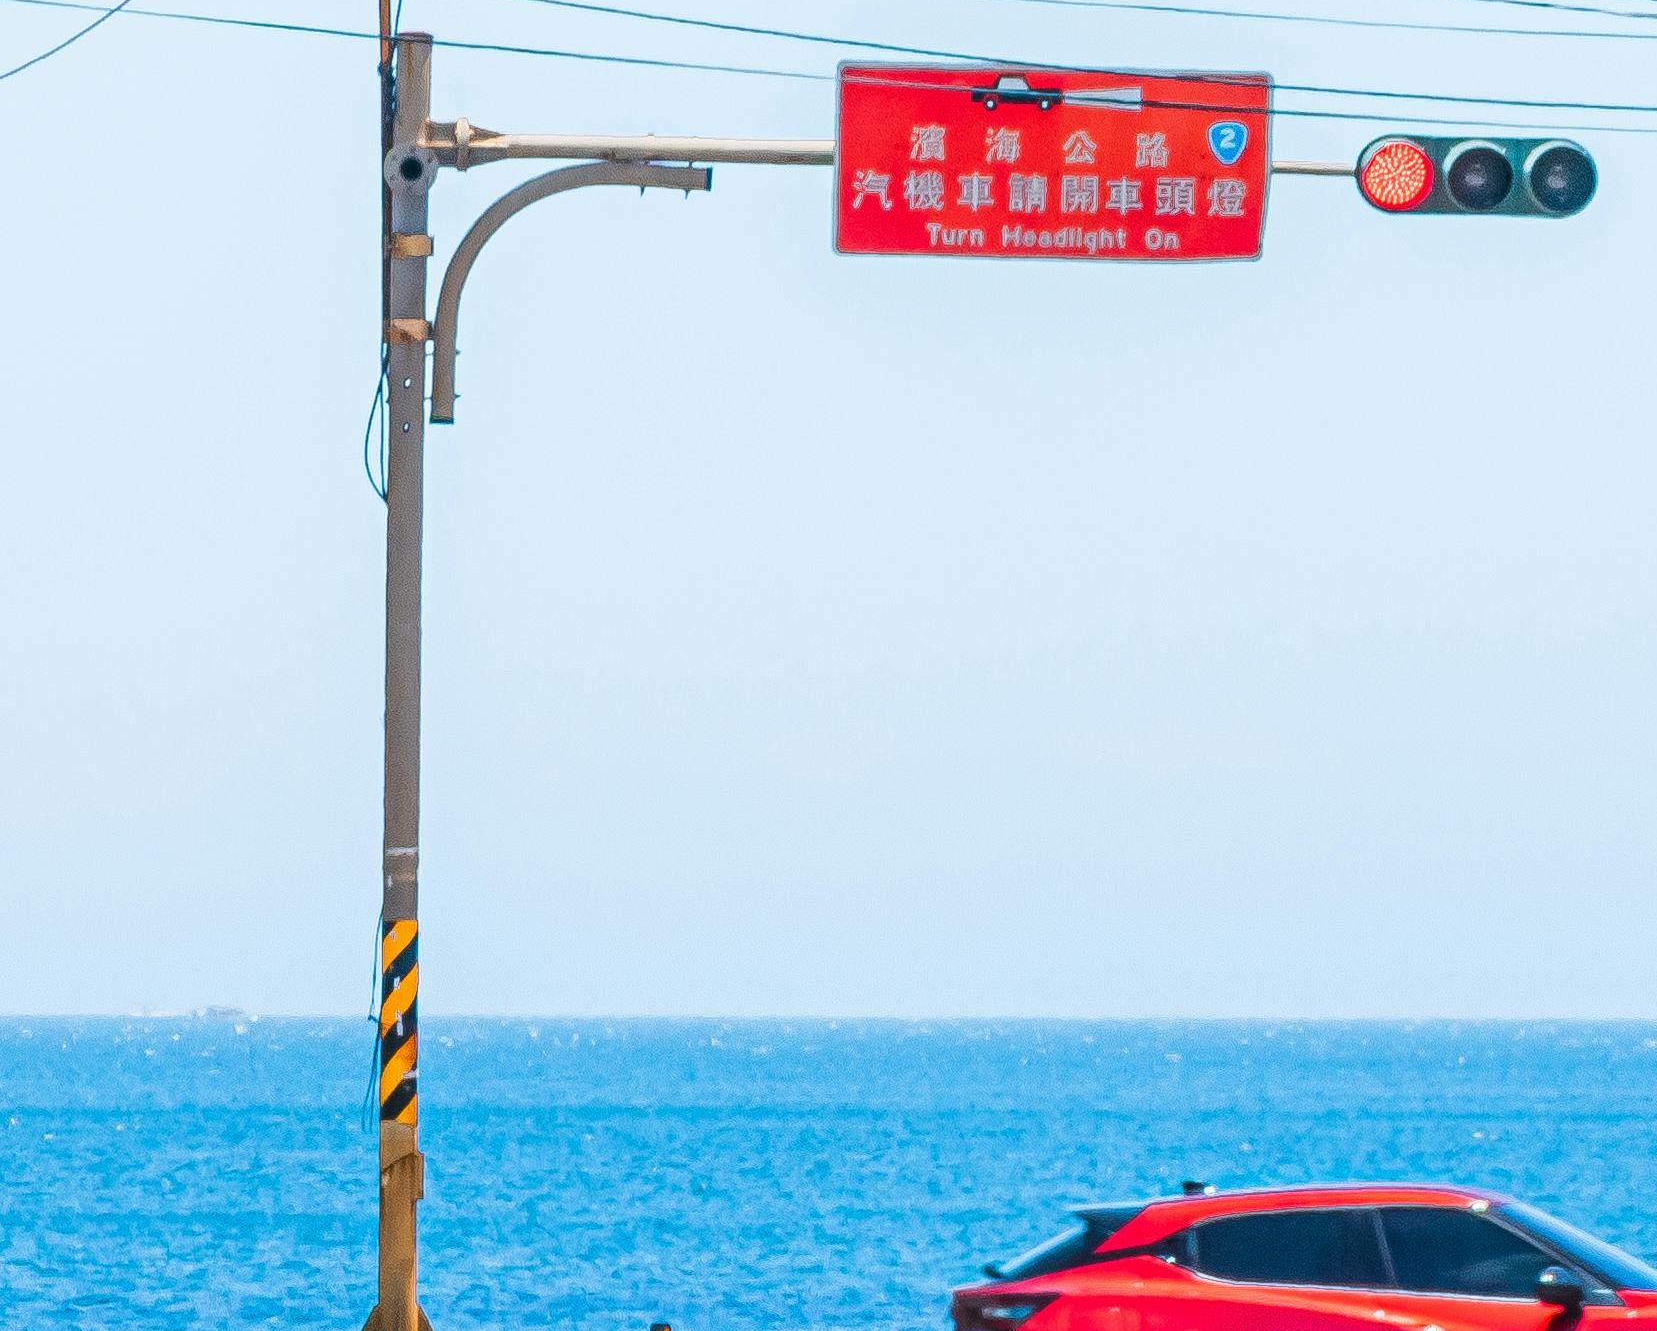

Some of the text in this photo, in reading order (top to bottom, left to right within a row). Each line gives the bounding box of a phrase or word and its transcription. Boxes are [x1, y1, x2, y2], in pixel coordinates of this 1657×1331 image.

[909, 125, 1237, 168] 濱海公路 2
[852, 170, 1247, 217] 汽機車請開車頭燈
[926, 222, 1179, 254] Turn Headlight On
